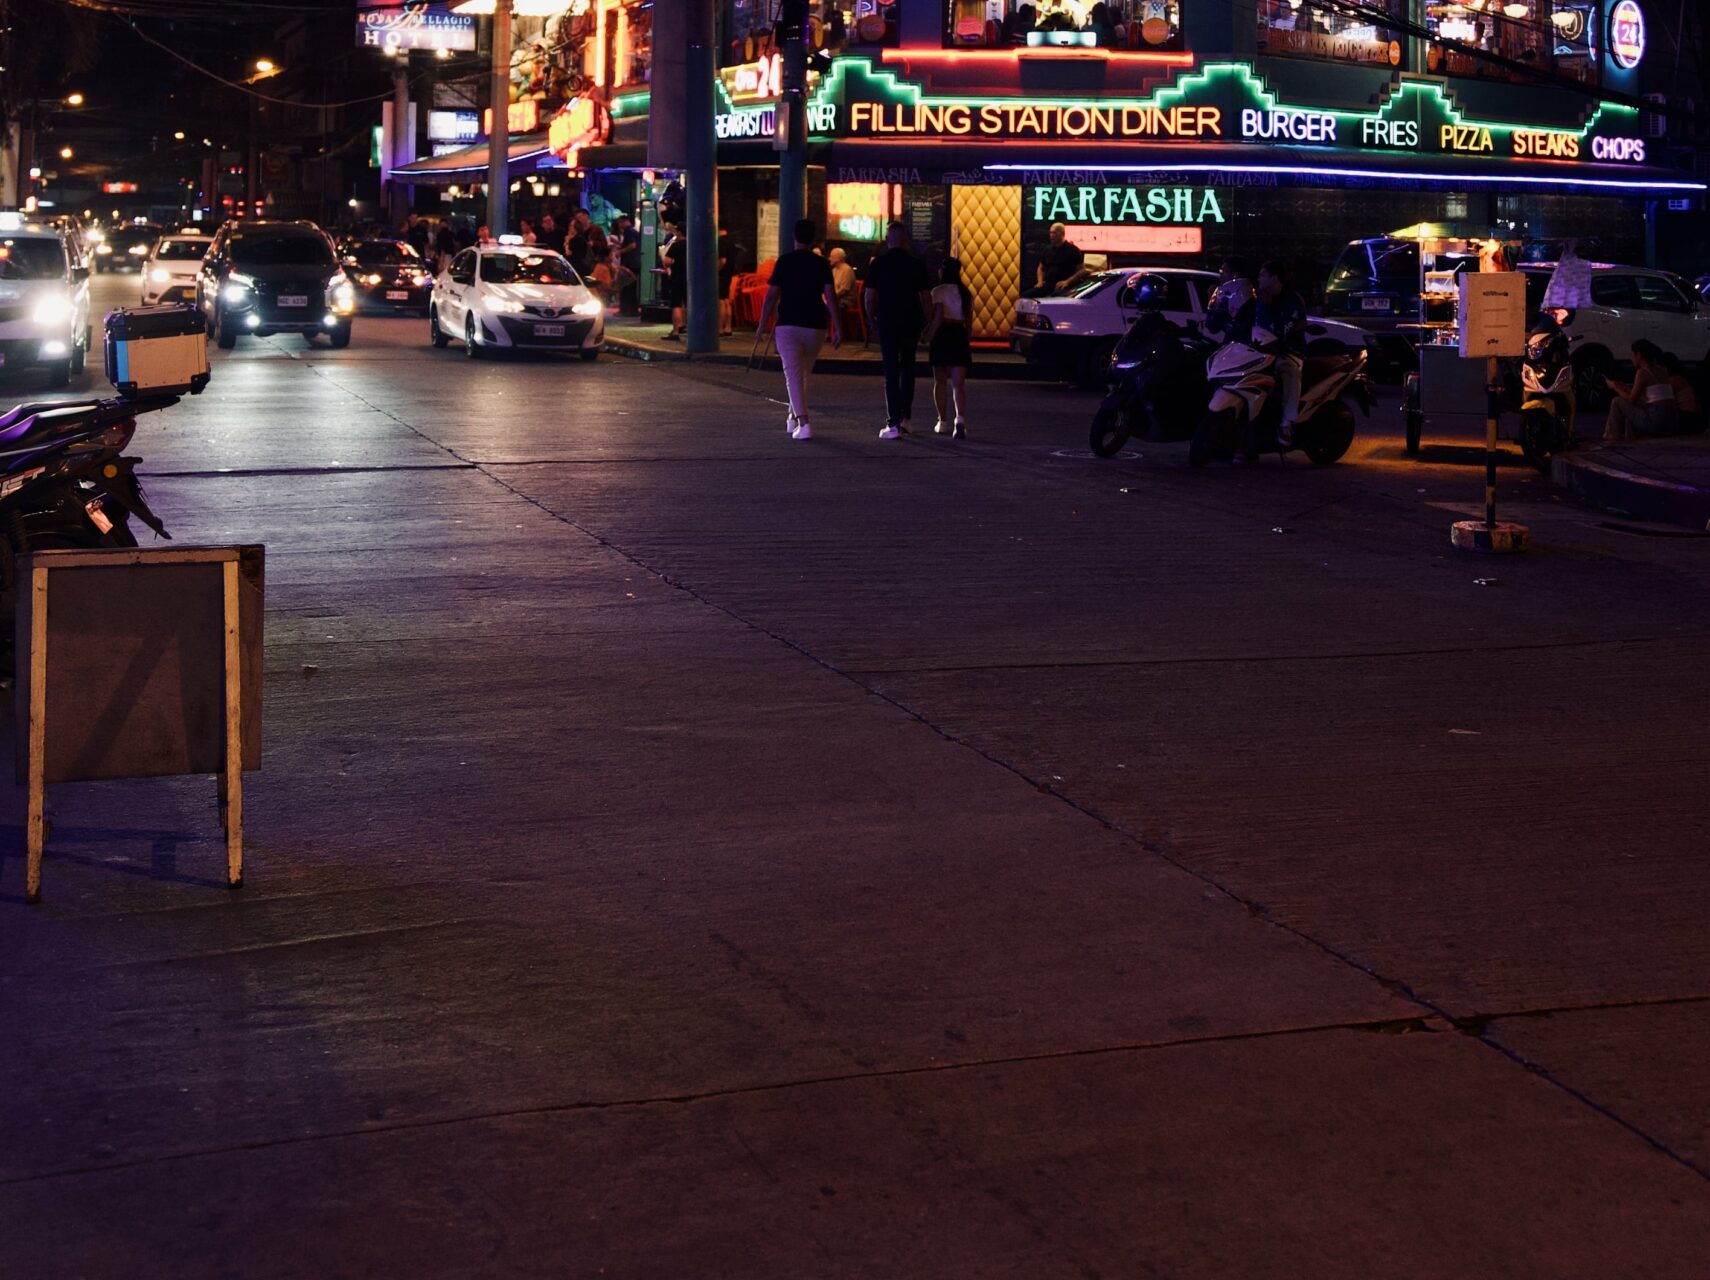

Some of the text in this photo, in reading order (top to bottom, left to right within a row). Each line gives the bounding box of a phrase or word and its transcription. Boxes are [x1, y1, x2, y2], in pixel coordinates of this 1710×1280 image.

[413, 15, 471, 25] BELLAGIO
[364, 30, 465, 47] HOTEL
[851, 103, 1222, 136] FILLING STATION DINER
[1241, 108, 1646, 161] BURGER FRIES PIZZA STEAKS CHOPS
[838, 167, 922, 183] FARFASHA
[1023, 170, 1107, 184] FARFASHA
[1034, 186, 1225, 224] FARFASHA
